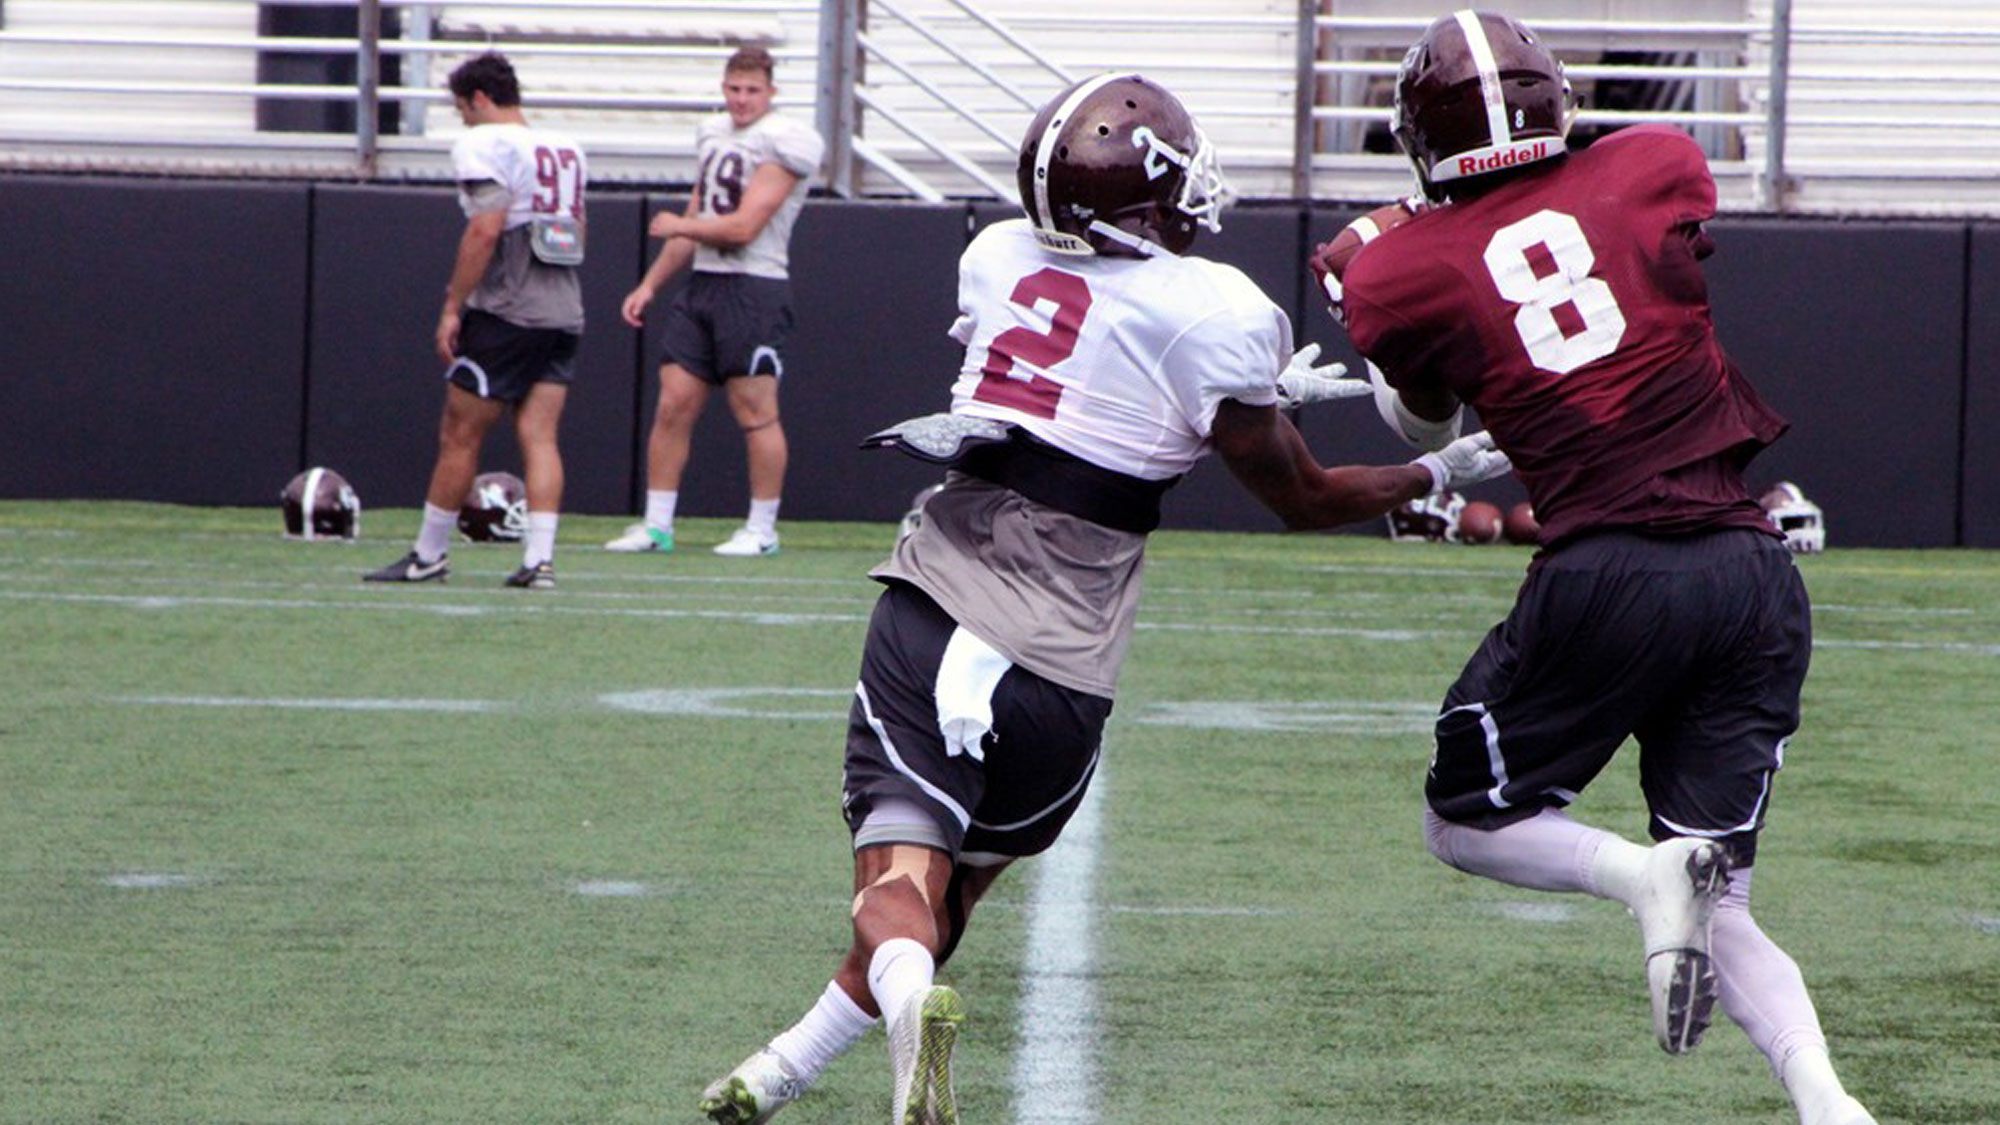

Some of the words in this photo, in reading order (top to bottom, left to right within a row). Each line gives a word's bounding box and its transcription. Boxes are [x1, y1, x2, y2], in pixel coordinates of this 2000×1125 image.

[1515, 109, 1525, 128] 8
[532, 146, 581, 217] 97
[1132, 126, 1169, 181] 2
[1458, 142, 1547, 175] Riddell
[1483, 209, 1627, 374] 8
[972, 266, 1093, 421] 2
